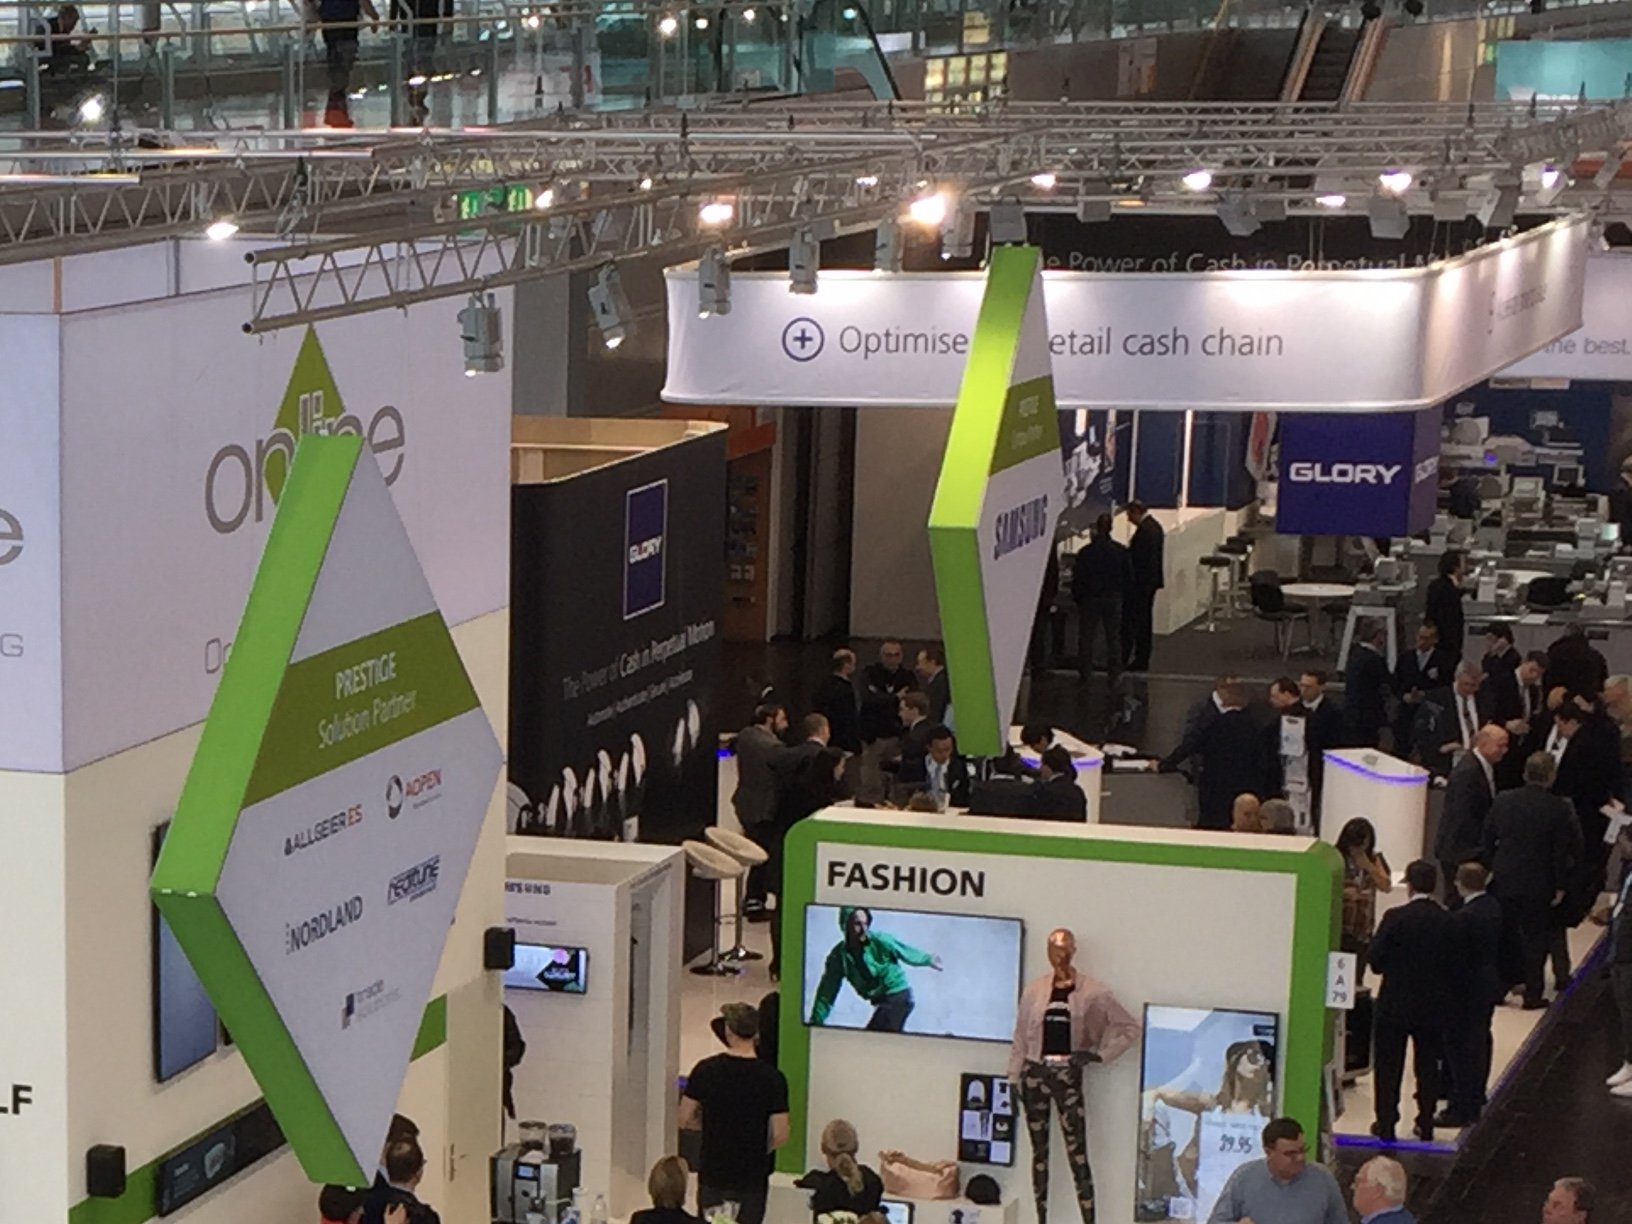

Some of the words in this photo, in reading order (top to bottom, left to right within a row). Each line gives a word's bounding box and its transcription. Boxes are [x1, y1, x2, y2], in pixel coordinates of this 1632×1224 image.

[839, 325, 968, 356] Optimise
[1048, 327, 1112, 356] etail
[1123, 327, 1189, 356] cash
[1202, 327, 1284, 356] chain
[1289, 462, 1401, 484] GLORY
[335, 652, 396, 700] PRESTIGE
[827, 860, 985, 898] FASHION
[290, 894, 363, 951] NORDLAND
